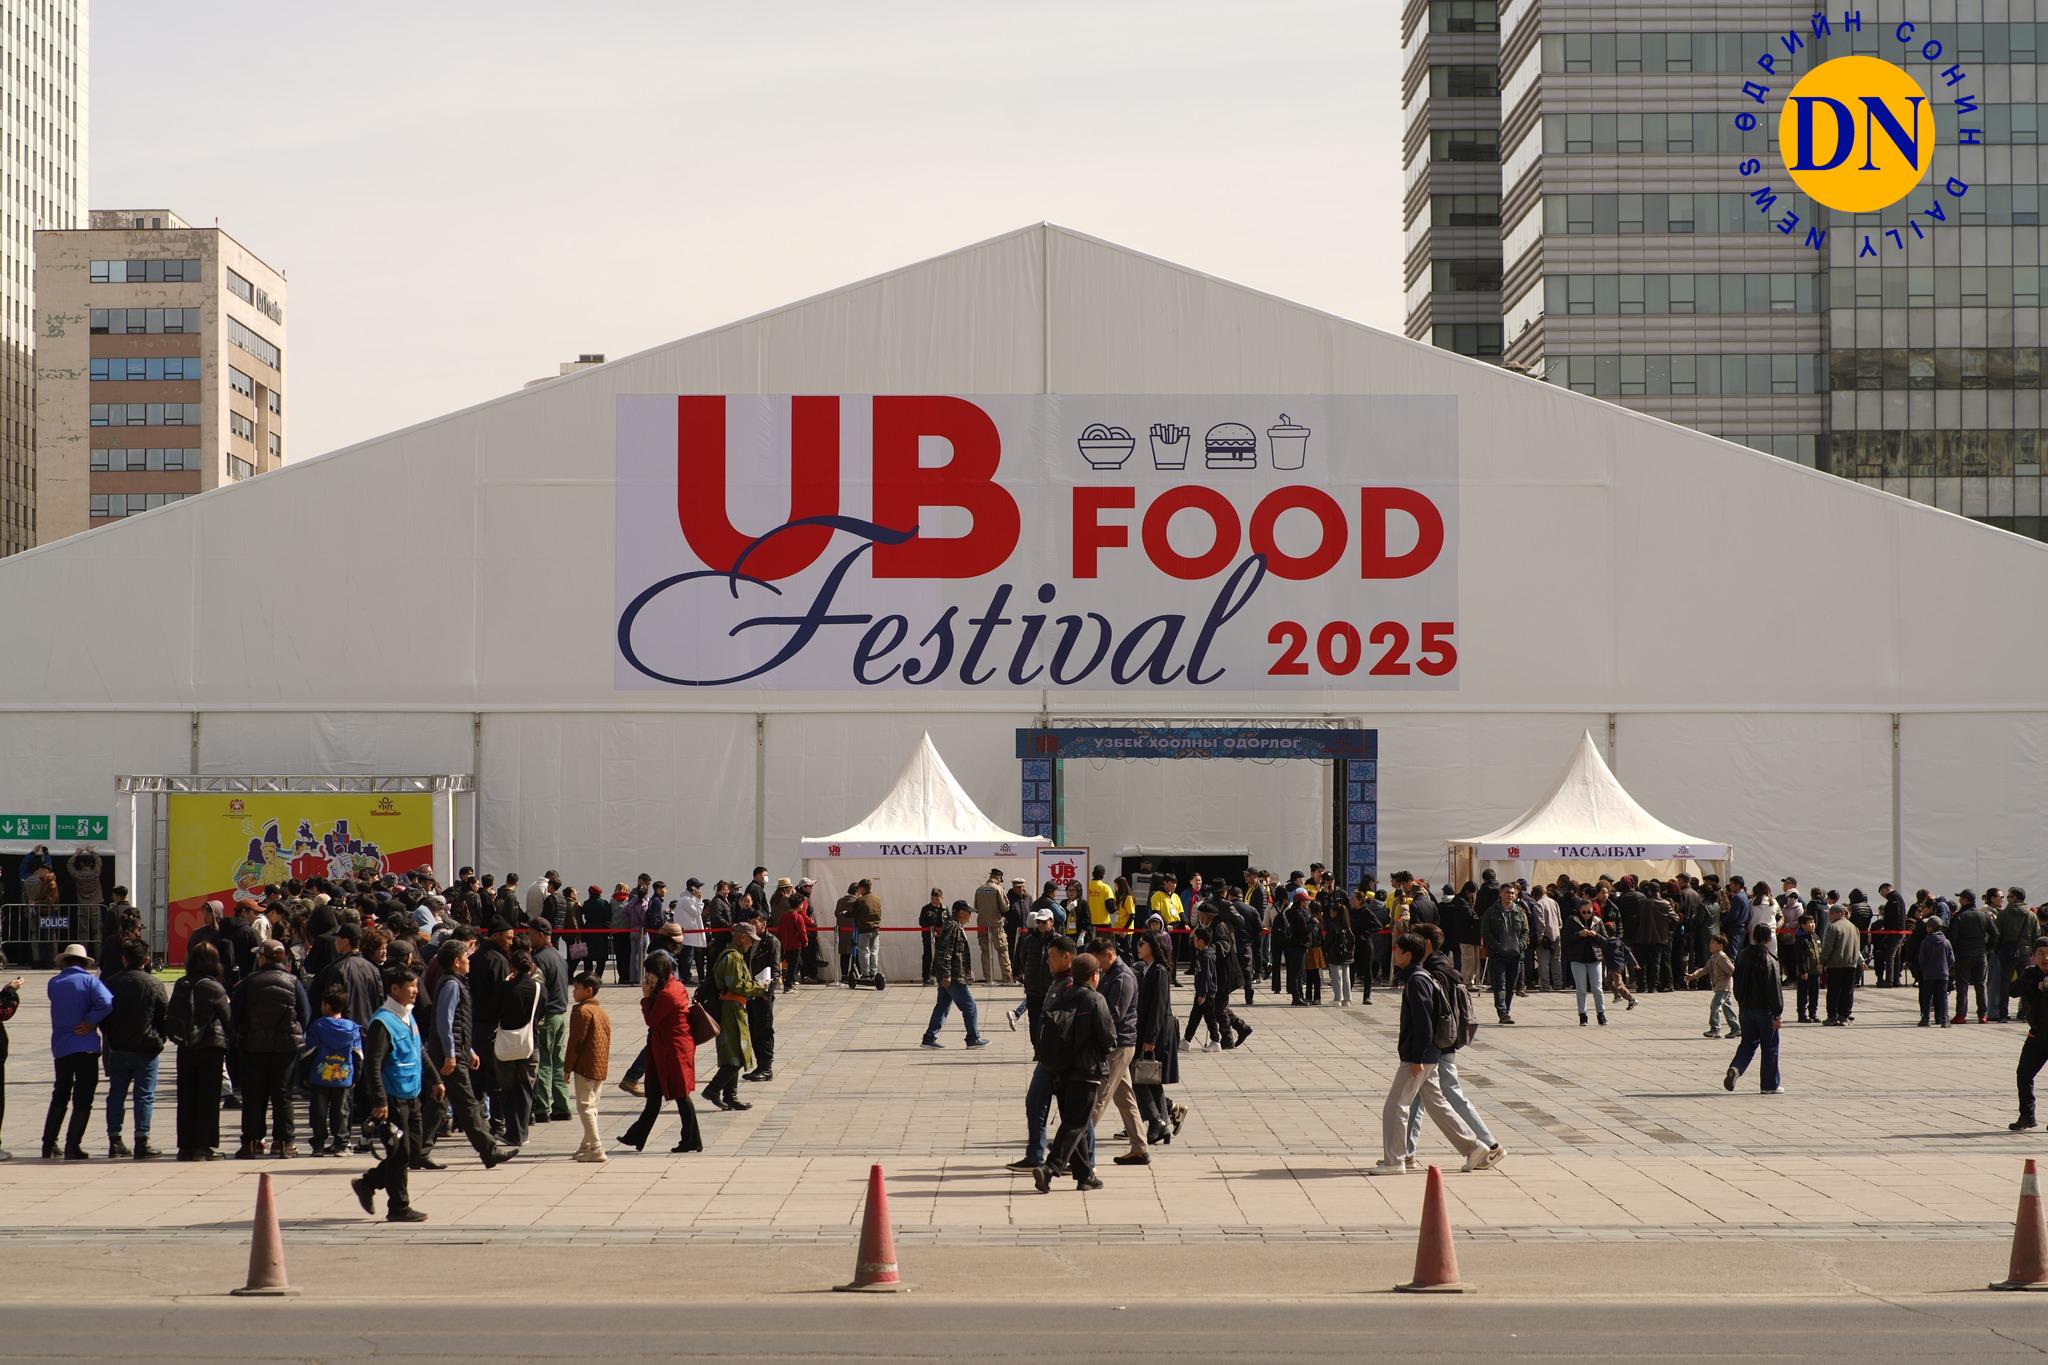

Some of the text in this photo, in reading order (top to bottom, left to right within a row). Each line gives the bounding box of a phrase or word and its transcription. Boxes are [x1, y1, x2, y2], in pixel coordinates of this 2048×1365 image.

[678, 395, 1020, 581] UB
[1073, 486, 1444, 580] FOOD
[618, 515, 1268, 686] Festival
[1267, 621, 1457, 676] 2025
[1094, 738, 1143, 748] УЗБЕК
[1149, 738, 1218, 748] ХООЛНЫ
[880, 844, 968, 856] ТАСАЛБАР
[1558, 846, 1646, 857] ТАСАЛБАР
[1051, 864, 1075, 878] UB
[40, 917, 68, 928] POLICE
